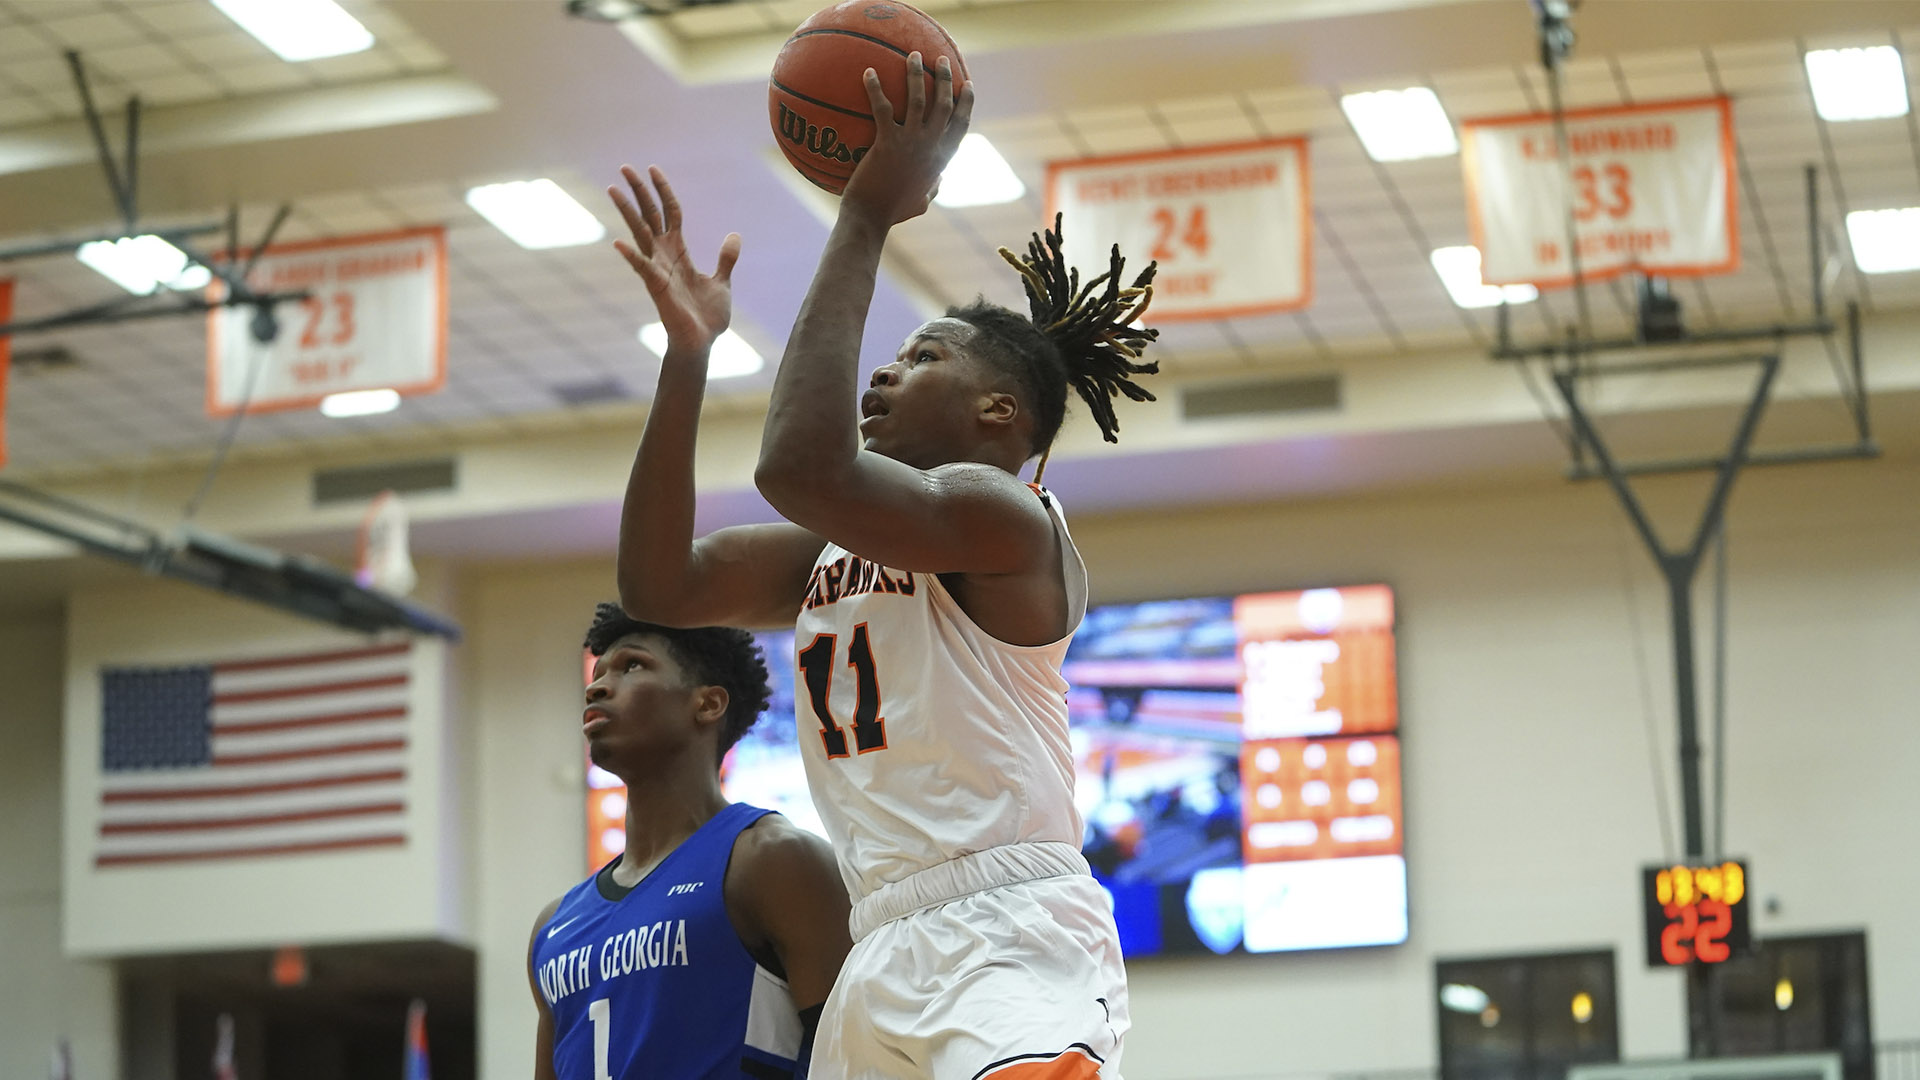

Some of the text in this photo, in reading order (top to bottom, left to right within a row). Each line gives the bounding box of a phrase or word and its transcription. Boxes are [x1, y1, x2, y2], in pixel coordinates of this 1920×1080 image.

[779, 101, 871, 165] Wilso
[1572, 163, 1633, 222] 33
[1149, 205, 1211, 262] 24
[298, 290, 356, 348] 23
[799, 621, 888, 760] 11
[539, 919, 689, 1008] NORTH GEORGIA
[1661, 899, 1733, 965] 22
[589, 998, 613, 1080] 1
